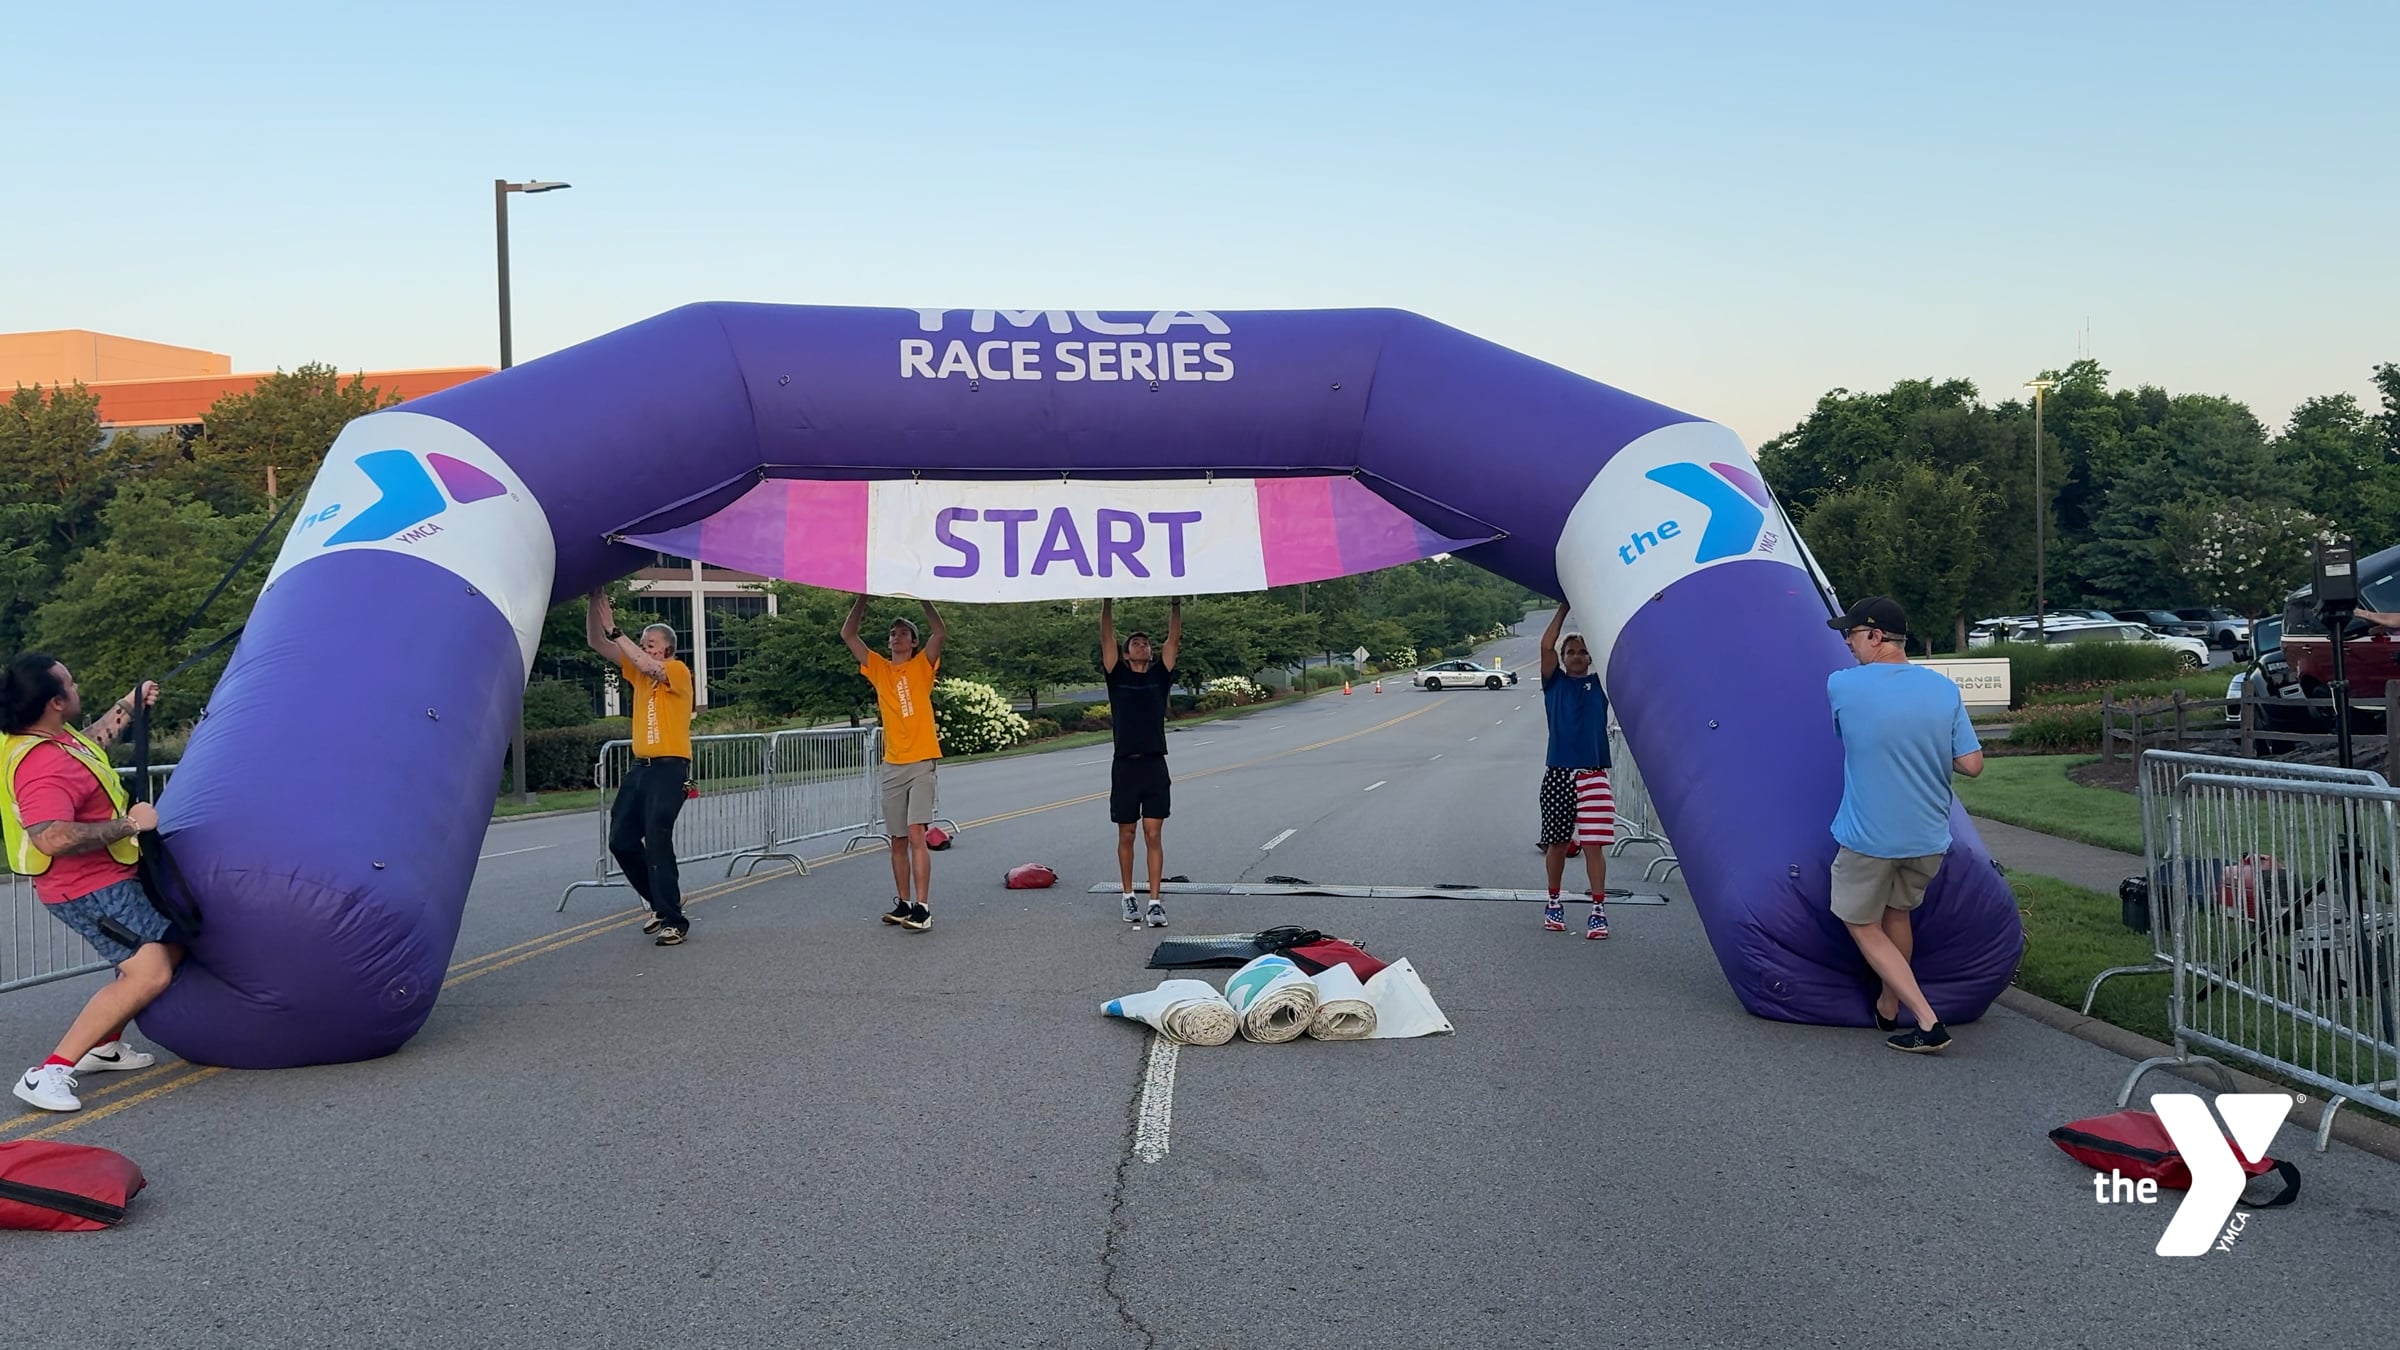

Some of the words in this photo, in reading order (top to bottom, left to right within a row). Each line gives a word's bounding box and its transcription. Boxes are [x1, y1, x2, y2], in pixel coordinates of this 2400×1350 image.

[900, 338, 1042, 380] RACE
[1055, 341, 1235, 382] SERIES
[296, 503, 342, 536] he
[396, 522, 444, 544] YMCA
[933, 506, 1202, 578] START
[1618, 520, 1682, 565] the
[1758, 531, 1779, 554] YMCA
[647, 698, 655, 745] VOLUNTEER
